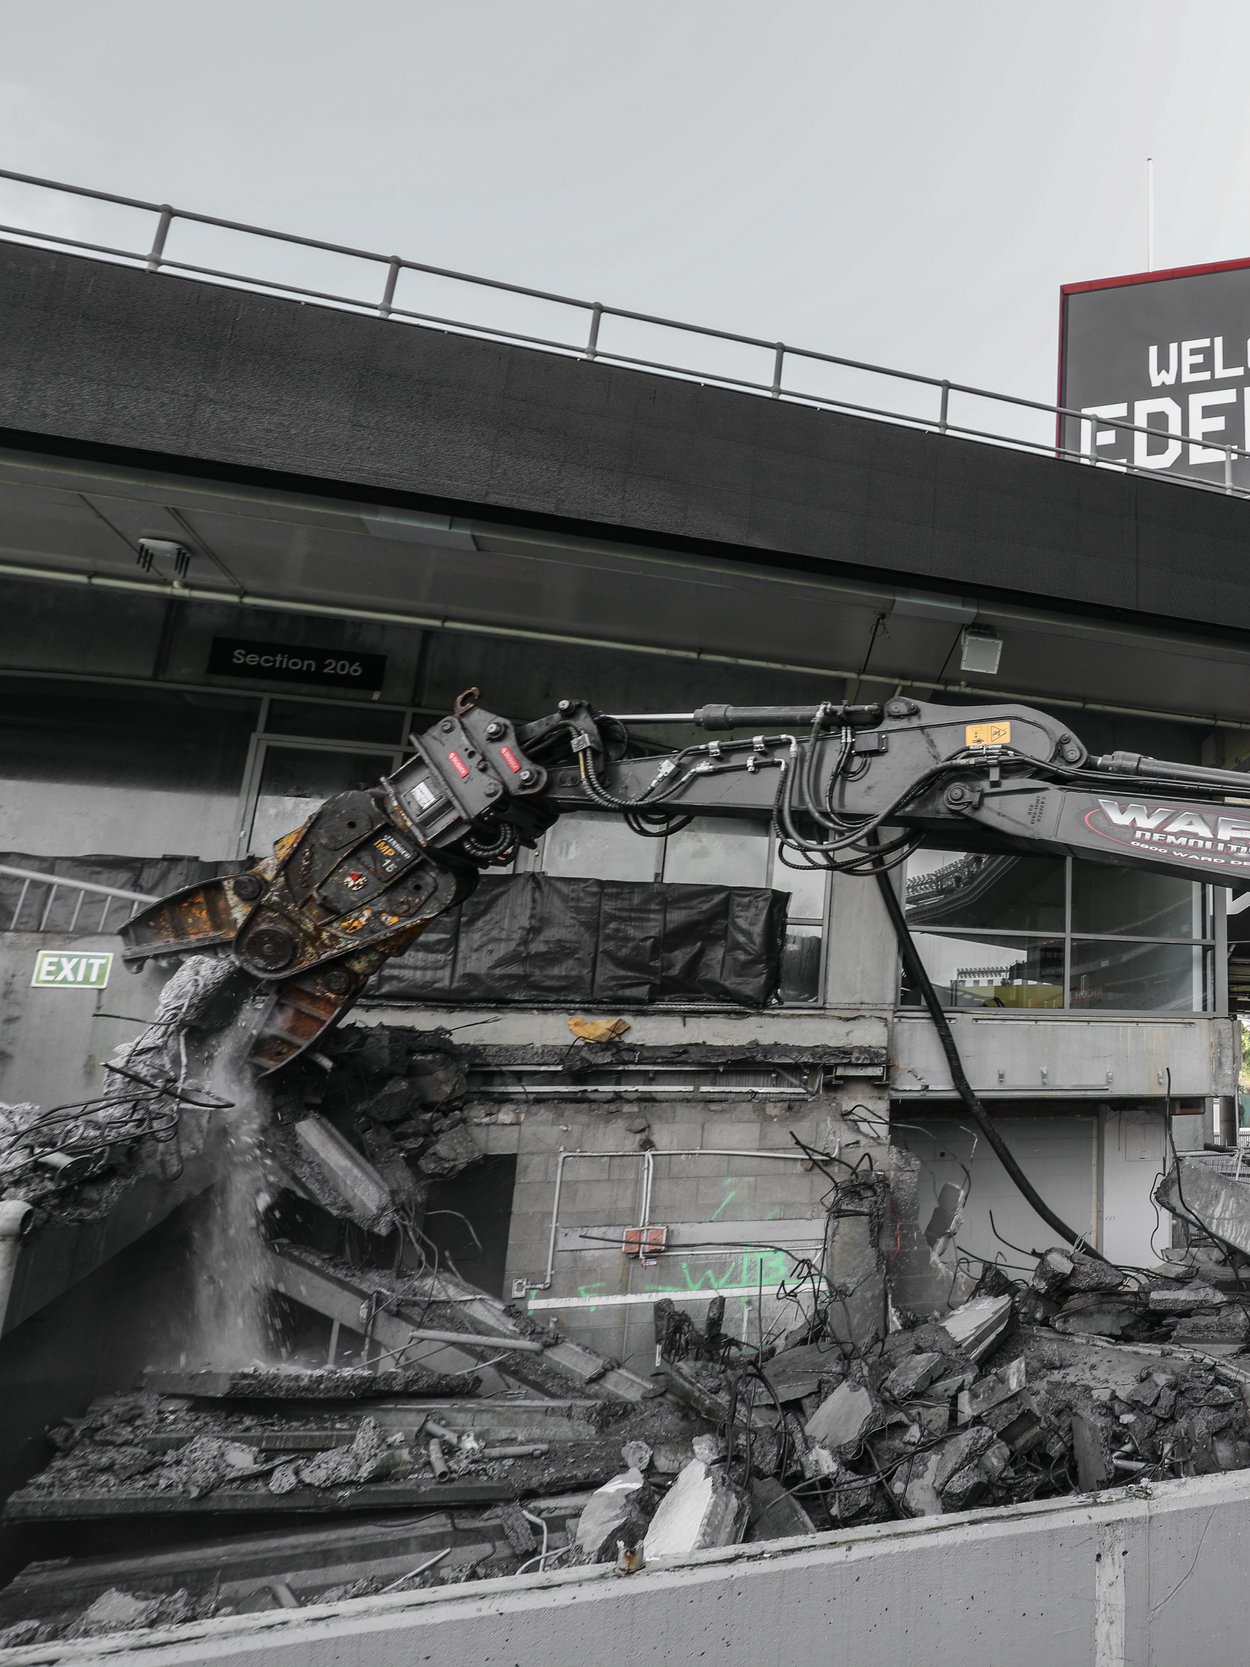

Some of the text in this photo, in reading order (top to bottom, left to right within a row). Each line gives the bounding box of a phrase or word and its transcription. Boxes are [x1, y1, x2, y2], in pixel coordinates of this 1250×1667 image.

[232, 649, 363, 676] Section 206
[374, 839, 396, 857] IMP
[1131, 841, 1168, 855] 0800
[1173, 852, 1226, 863] WARD
[38, 957, 107, 982] EXIT
